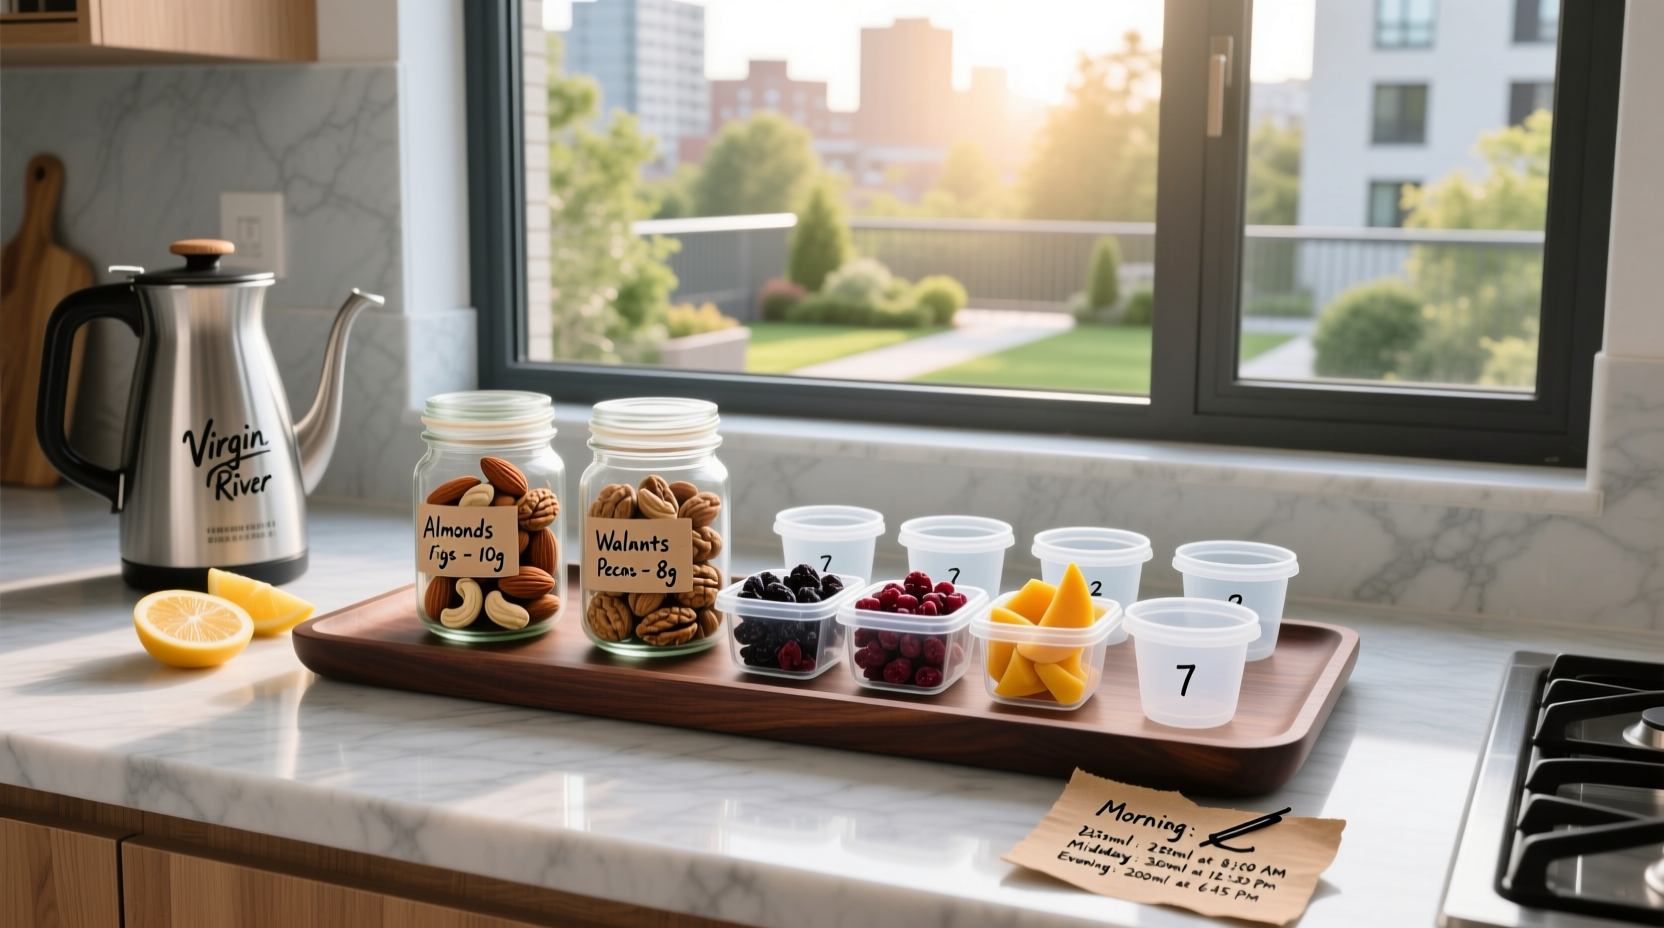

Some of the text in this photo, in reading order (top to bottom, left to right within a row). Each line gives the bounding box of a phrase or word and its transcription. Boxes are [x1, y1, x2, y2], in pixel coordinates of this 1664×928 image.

[215, 469, 272, 501] River
[423, 515, 493, 539] Almonds
[479, 546, 504, 572] 10g
[656, 560, 677, 587] 8g
[1176, 664, 1196, 697] 7
[1260, 865, 1286, 879] AM
[1234, 889, 1259, 902] PM
